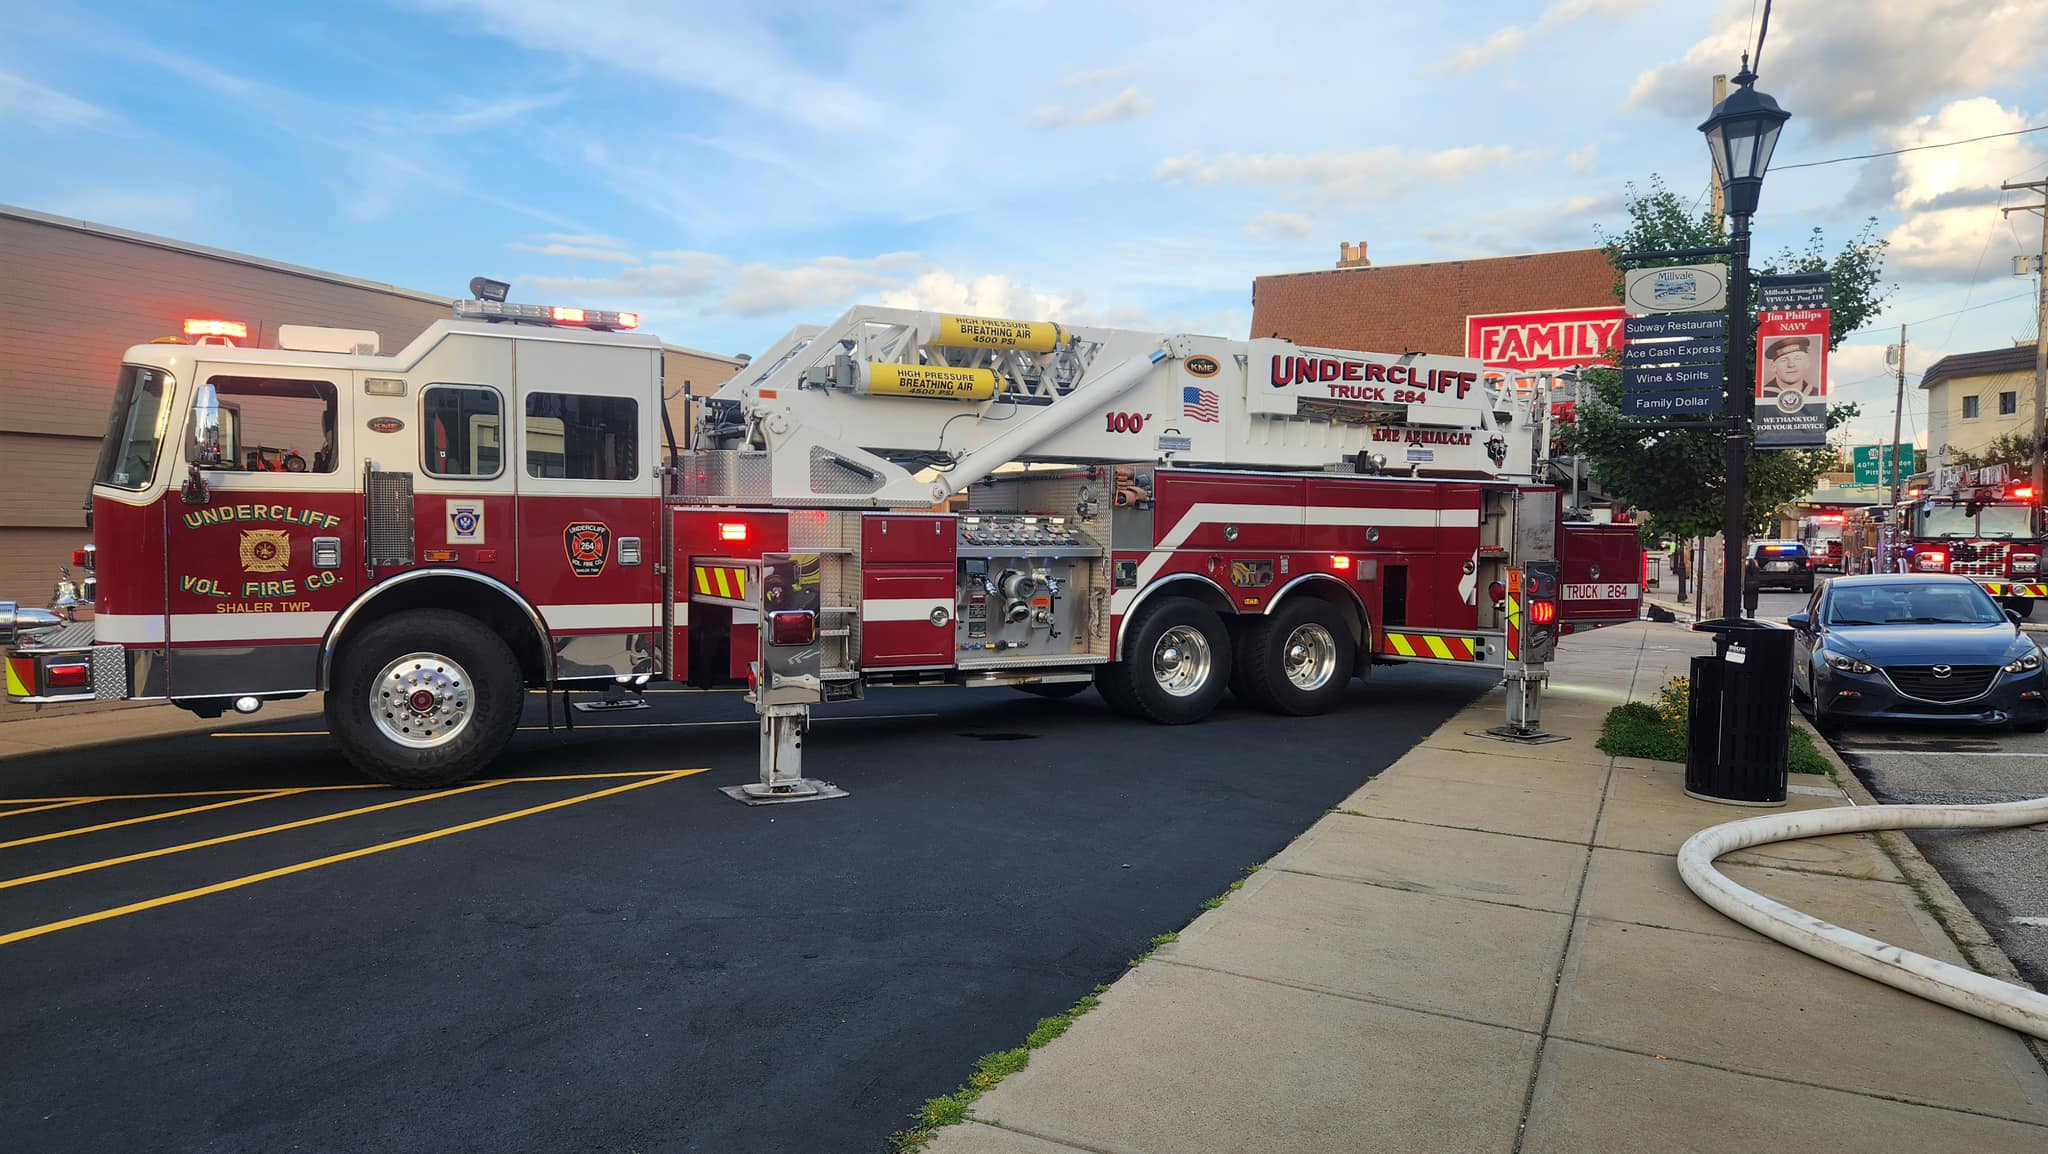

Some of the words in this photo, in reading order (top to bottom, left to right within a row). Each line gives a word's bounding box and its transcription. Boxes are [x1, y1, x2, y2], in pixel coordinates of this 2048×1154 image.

[1658, 271, 1693, 280] Millvale
[956, 317, 979, 326] HIGH
[981, 319, 1031, 330] PRESSURE
[1765, 312, 1783, 323] Jim
[1785, 310, 1822, 321] Phillips
[960, 325, 1013, 338] BREATHING
[1015, 328, 1031, 339] AIR
[1626, 322, 1665, 334] Subway
[1667, 319, 1722, 331] Restaurant
[1780, 322, 1808, 331] NAVY
[972, 335, 998, 344] 4500
[1000, 337, 1016, 346] PSI
[1480, 319, 1624, 363] FAMILY
[1626, 349, 1646, 358] Ace
[1648, 346, 1675, 357] Cash
[1678, 344, 1722, 357] Express
[1190, 362, 1214, 373] KME
[897, 369, 921, 379] HIGH
[924, 371, 975, 382] PRESSURE
[1271, 355, 1478, 400] UNDERCLIFF
[1636, 373, 1663, 384] Wine
[1666, 372, 1674, 382] &
[1675, 370, 1709, 381] Spirits
[899, 377, 955, 391] BREATHING
[957, 380, 973, 391] AIR
[1328, 384, 1385, 401] TRUCK
[1393, 389, 1426, 404] 264
[1636, 398, 1672, 409] Family
[1675, 396, 1709, 407] Dollar
[1404, 430, 1472, 445] AERIALCAT
[183, 504, 341, 529] UNDERCLIFF
[569, 525, 605, 533] UNDERCLIFF
[581, 542, 594, 550] 264
[180, 575, 232, 598] VOL.
[242, 579, 297, 599] FIRE
[305, 570, 344, 592] CO.
[1566, 584, 1598, 599] TRUCK
[1607, 584, 1628, 598] 264
[216, 601, 274, 614] SHALER
